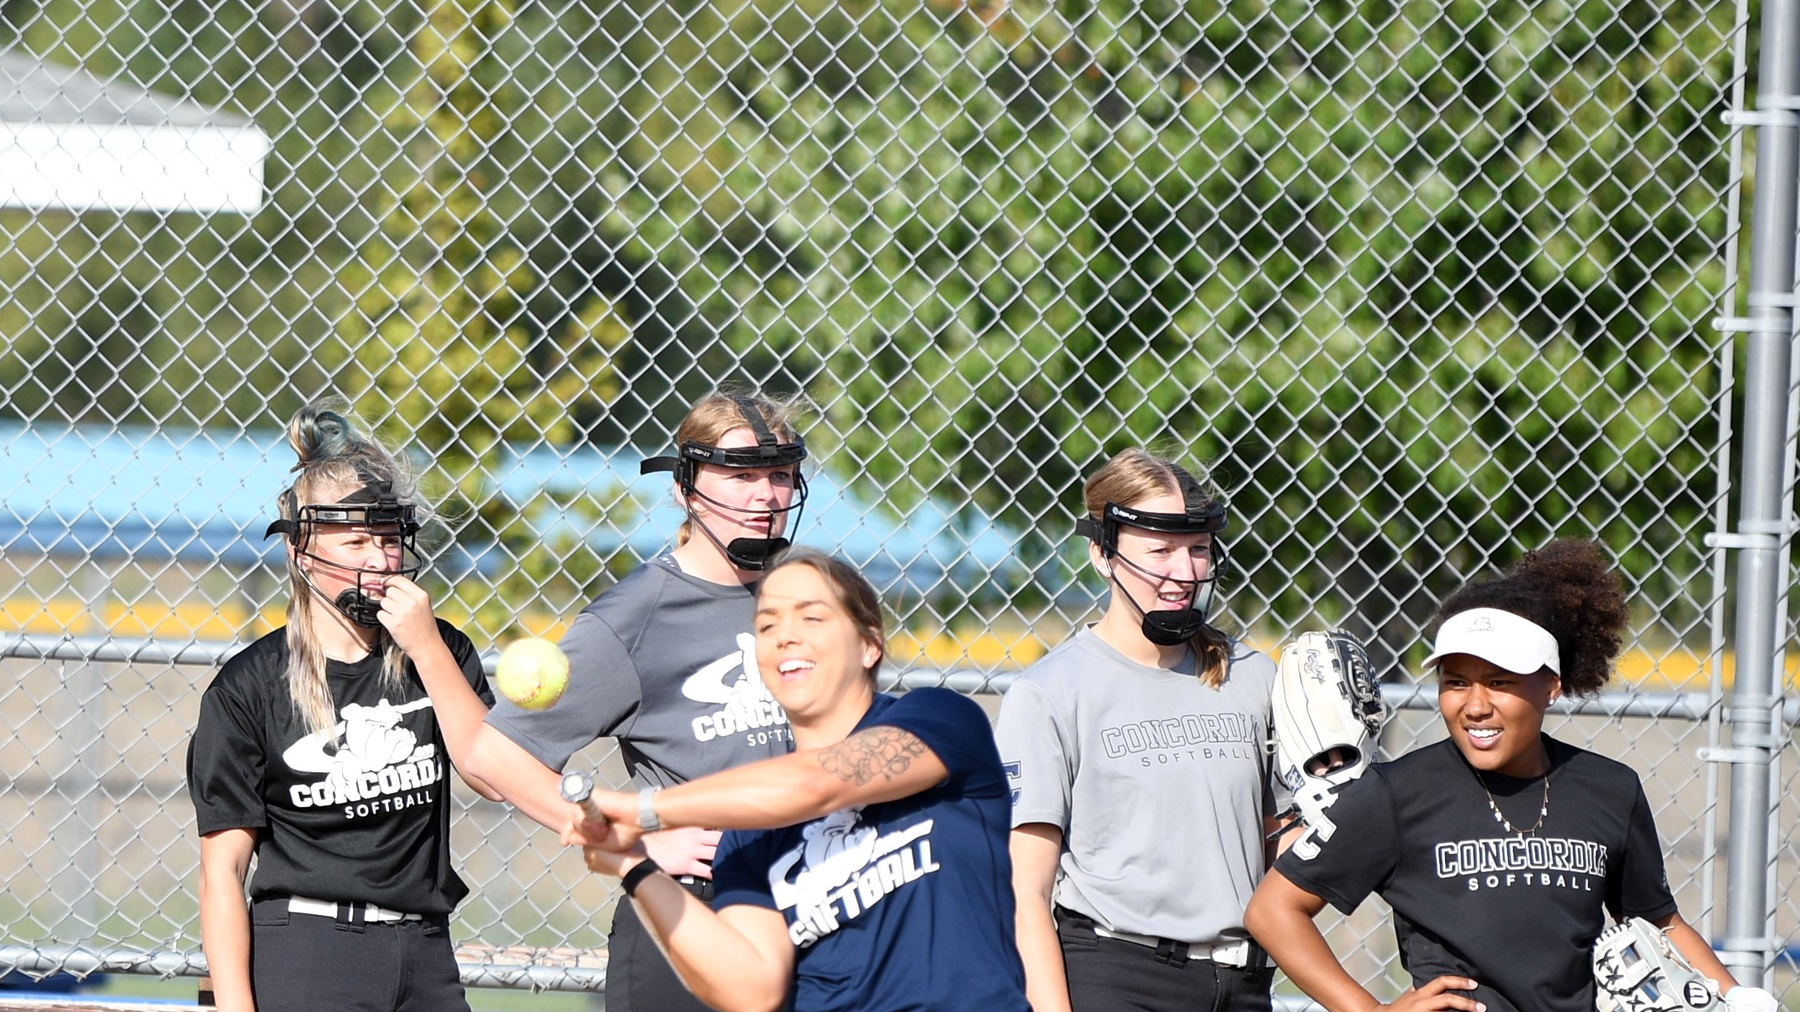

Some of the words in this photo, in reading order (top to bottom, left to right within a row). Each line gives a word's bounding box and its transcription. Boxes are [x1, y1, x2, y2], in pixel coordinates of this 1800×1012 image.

[691, 700, 791, 742] CONCO
[1141, 747, 1251, 768] SOFTBALL
[289, 757, 443, 808] CONCORD
[344, 790, 433, 819] SOFTBALL
[1435, 837, 1608, 879] CONCORDIA
[1468, 873, 1592, 891] SOFTBALL
